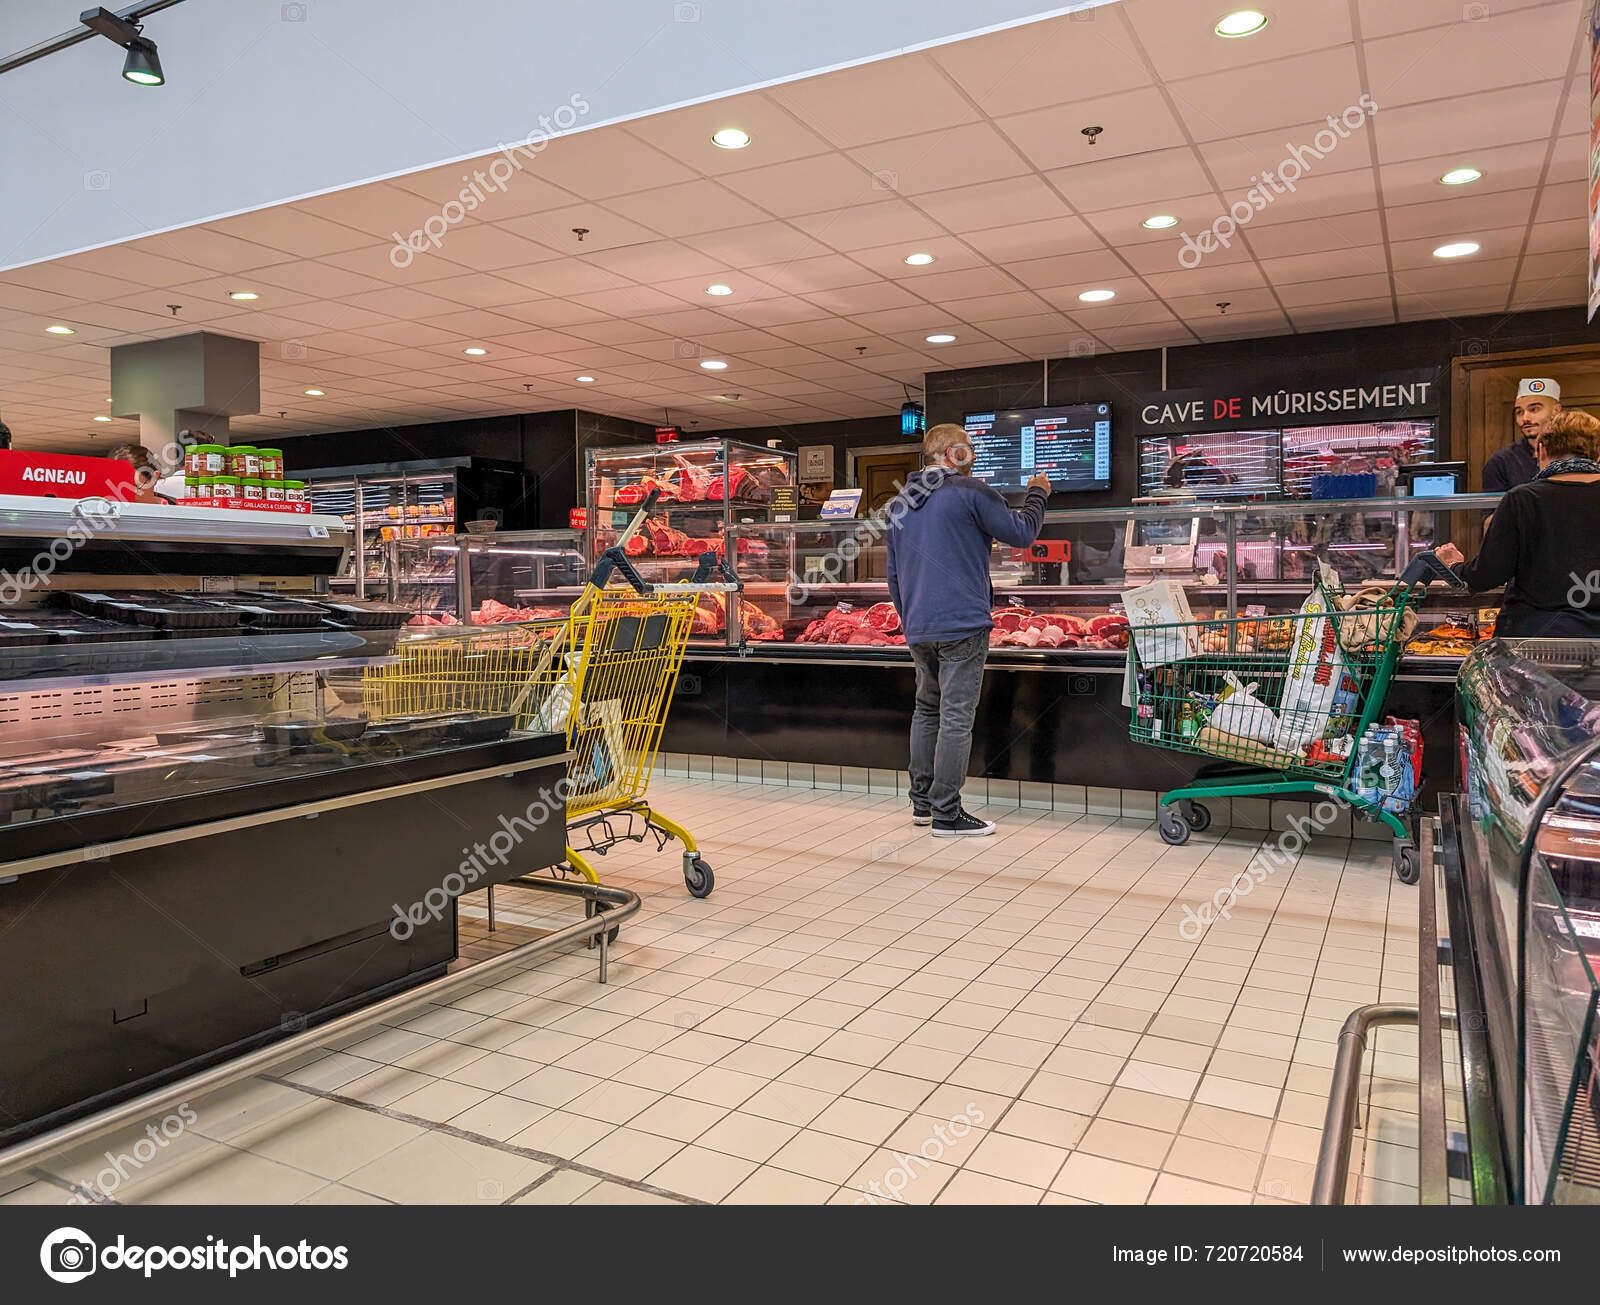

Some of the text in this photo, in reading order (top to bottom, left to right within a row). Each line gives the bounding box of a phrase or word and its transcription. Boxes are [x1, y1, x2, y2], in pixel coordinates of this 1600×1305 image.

[1141, 382, 1432, 425] CAVE DE MÛRISSEMENT
[22, 467, 86, 485] AGNEAU
[215, 488, 232, 497] BBQ
[243, 501, 270, 509] GRILLADES
